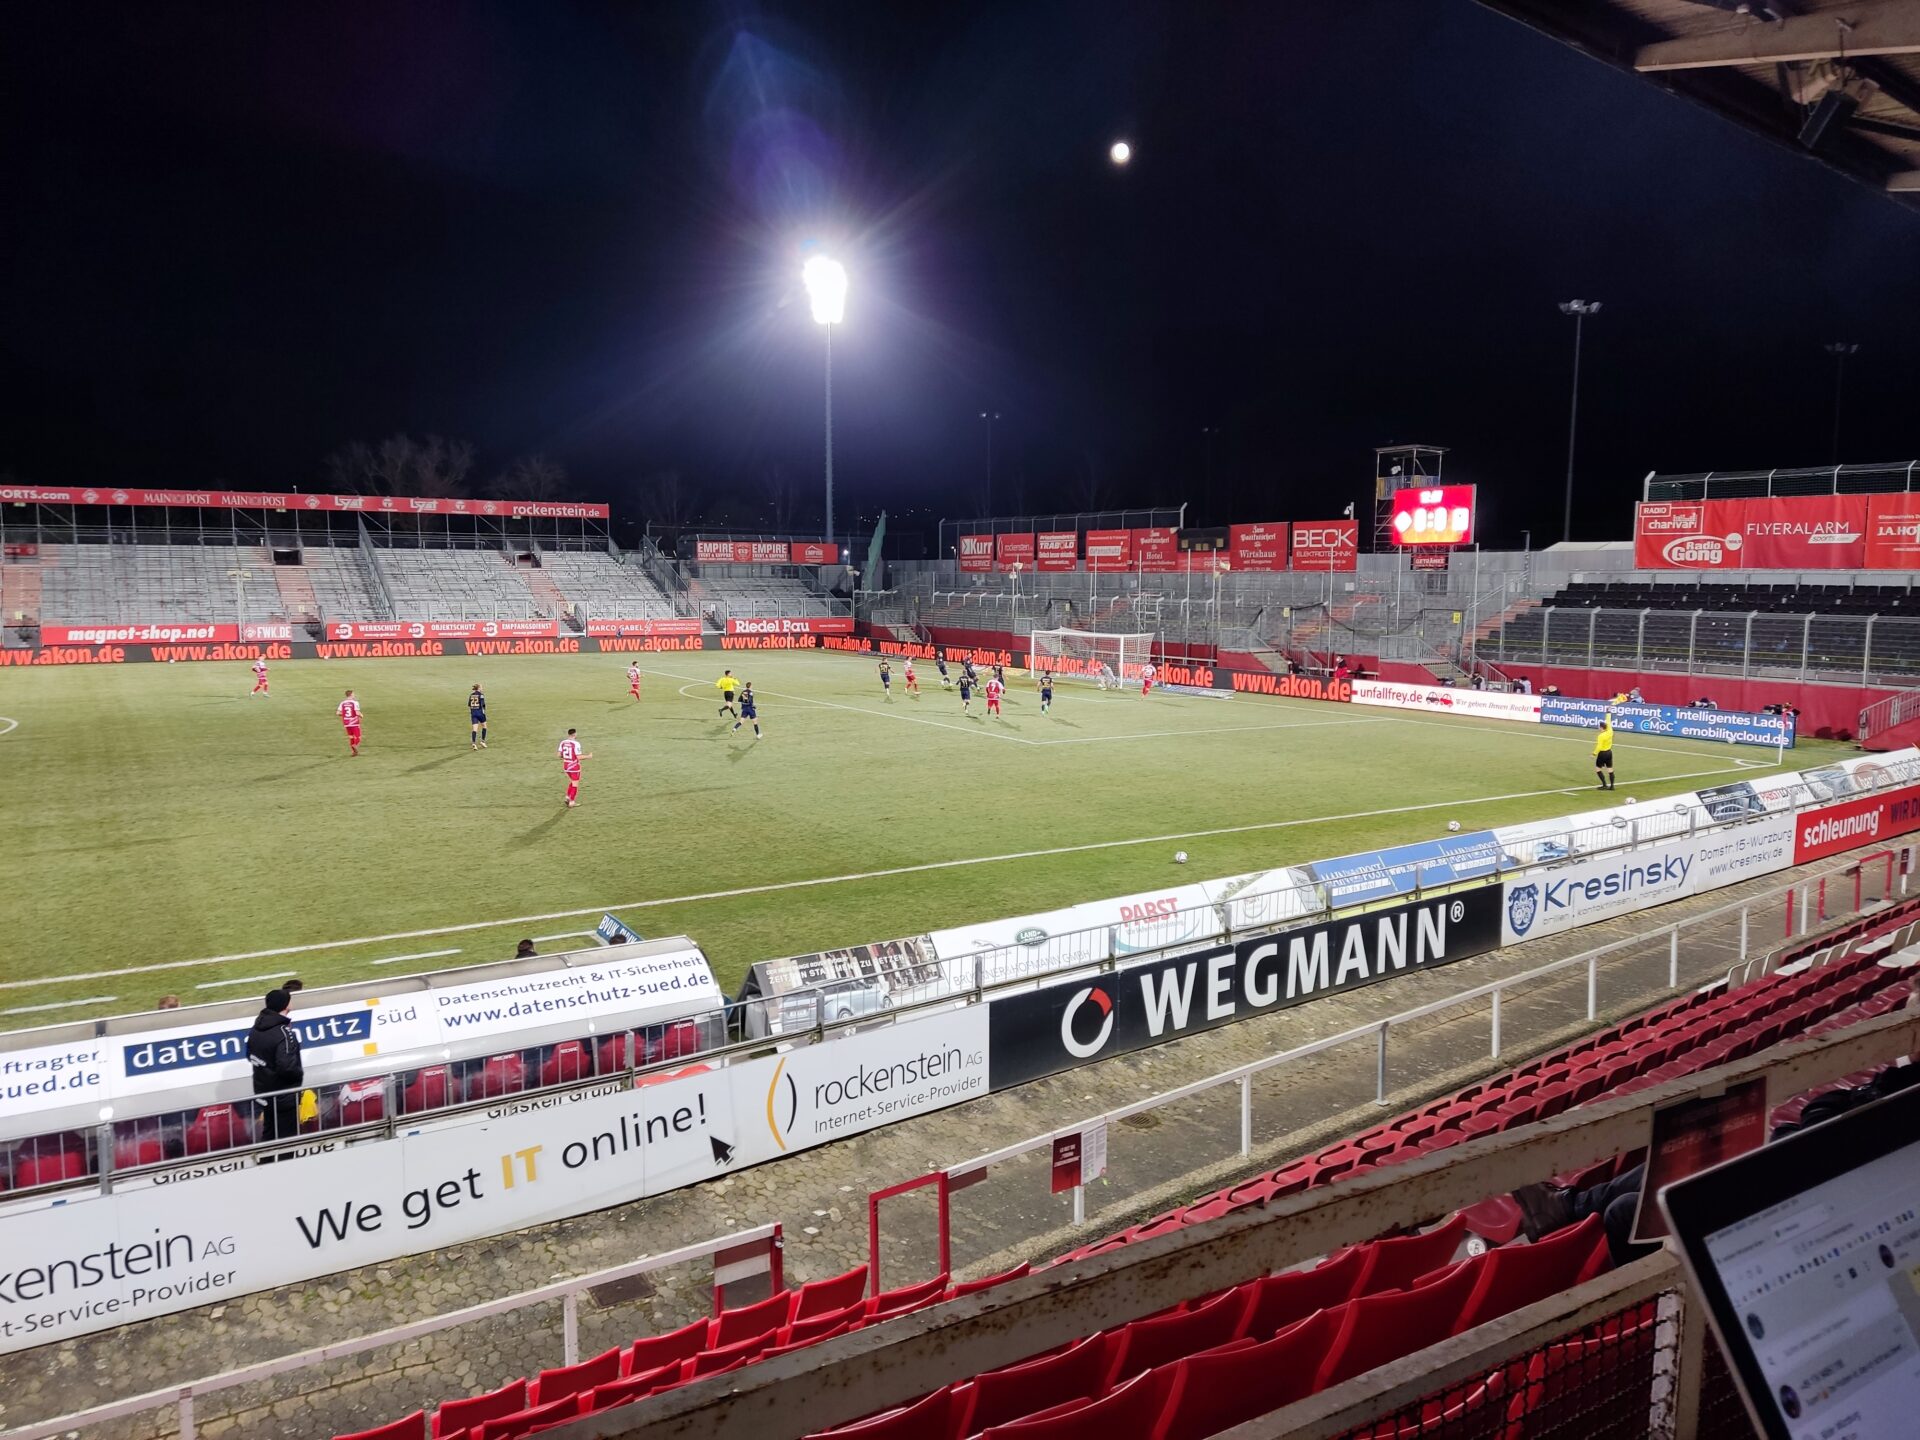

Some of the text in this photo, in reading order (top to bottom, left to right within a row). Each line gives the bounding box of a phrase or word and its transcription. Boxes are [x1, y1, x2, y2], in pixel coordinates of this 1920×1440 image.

[0, 489, 70, 500] ORTS.com
[144, 493, 211, 505] MAIN POST
[221, 494, 287, 506] MAIN POST
[513, 503, 600, 517] rockenstein.de
[1648, 518, 1697, 529] charivari
[1746, 521, 1850, 536] FLYERALARM
[970, 538, 992, 554] Kurr
[1294, 528, 1355, 548] BECK
[1686, 541, 1721, 550] Radio
[698, 543, 734, 552] EMPIRE
[752, 543, 787, 553] EMPIRE
[1146, 552, 1163, 560] Hotel
[1240, 550, 1277, 558] Wirtshaus
[1672, 546, 1723, 564] Gong
[257, 626, 292, 638] FWK.DE
[358, 624, 401, 632] WERKSCHUTZ
[502, 622, 552, 630] EMPFANGSDIENST
[588, 624, 617, 632] MARCO
[619, 623, 644, 632] GABEL
[735, 619, 809, 633] Riedel Bau
[68, 626, 215, 644] magnet-shop.net
[600, 635, 703, 652] www.akon.de
[721, 633, 816, 650] www.akon.de
[152, 642, 291, 662] www.akon.de
[316, 639, 443, 658] www.akon.de
[465, 638, 579, 655] www.akon.de
[824, 636, 871, 652] www.akon.de
[880, 641, 936, 659] www.akon.de
[1233, 672, 1351, 700] www.akon.de
[1360, 686, 1423, 703] unfallfrey.de
[470, 697, 480, 706] 22
[1541, 698, 1793, 730] Fuhrparkmanagement intelligentes Laden
[1543, 713, 1634, 730] emobilitycld.de
[1681, 725, 1790, 746] emobilitycloud.de
[563, 746, 572, 759] 21
[1890, 800, 1909, 824] WIR
[1803, 808, 1880, 847] schleunung
[1709, 847, 1783, 876] www.kresinsky.de
[1544, 854, 1693, 912] Kresinsky
[1119, 897, 1178, 928] PABST
[860, 959, 872, 968] ZU
[875, 954, 905, 966] ETZEN
[438, 955, 703, 1007] Datenschutzrecht & IT-Sicherheit
[444, 972, 709, 1027] www.datenschutz-sued.de
[132, 1006, 417, 1068] datenutz süd
[3, 1050, 100, 1075] ftragter
[815, 1043, 983, 1109] rockenstein AG
[814, 1075, 982, 1133] Internet-Service-Provider
[295, 1093, 707, 1249] We get IT online!
[202, 1236, 235, 1260] AG
